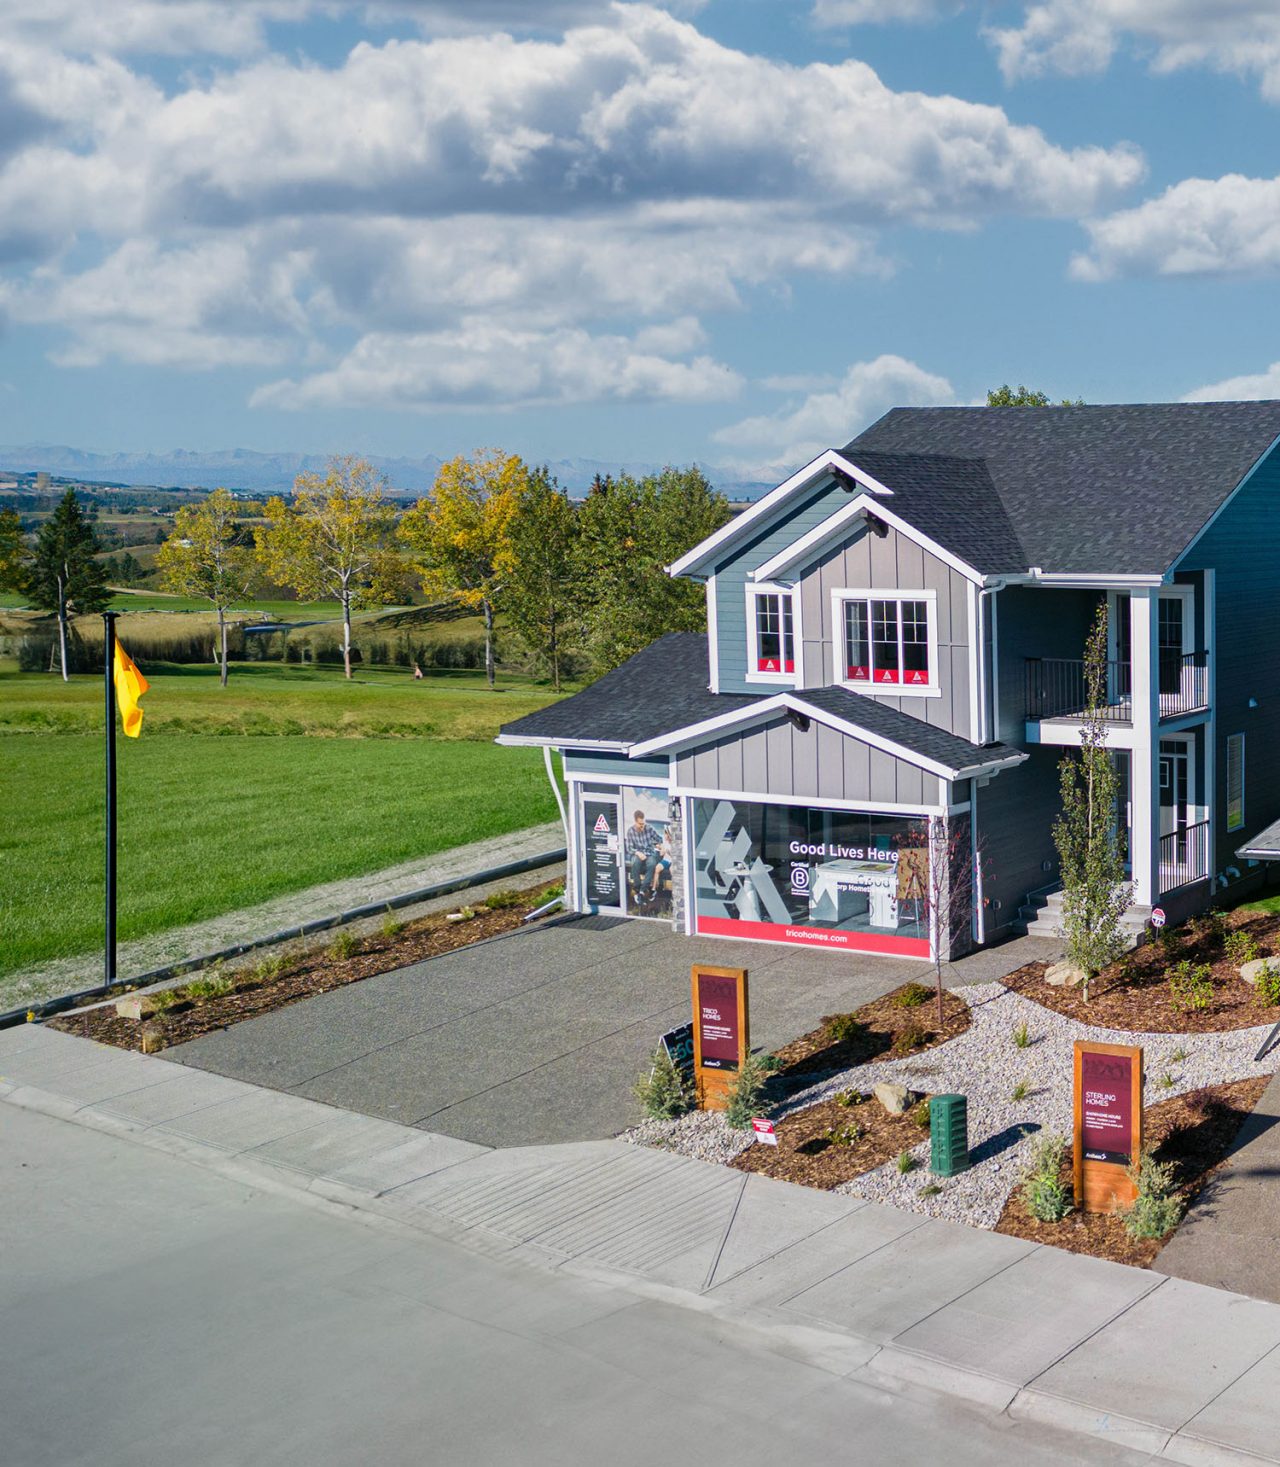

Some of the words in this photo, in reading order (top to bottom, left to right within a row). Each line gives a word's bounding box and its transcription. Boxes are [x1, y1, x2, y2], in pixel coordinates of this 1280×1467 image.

[789, 841, 826, 856] Good
[829, 844, 864, 859] Lives
[867, 847, 899, 861] Here
[785, 929, 848, 943] tricohomes.com
[1085, 1091, 1116, 1102] STERLING
[1085, 1099, 1109, 1107] HOMES
